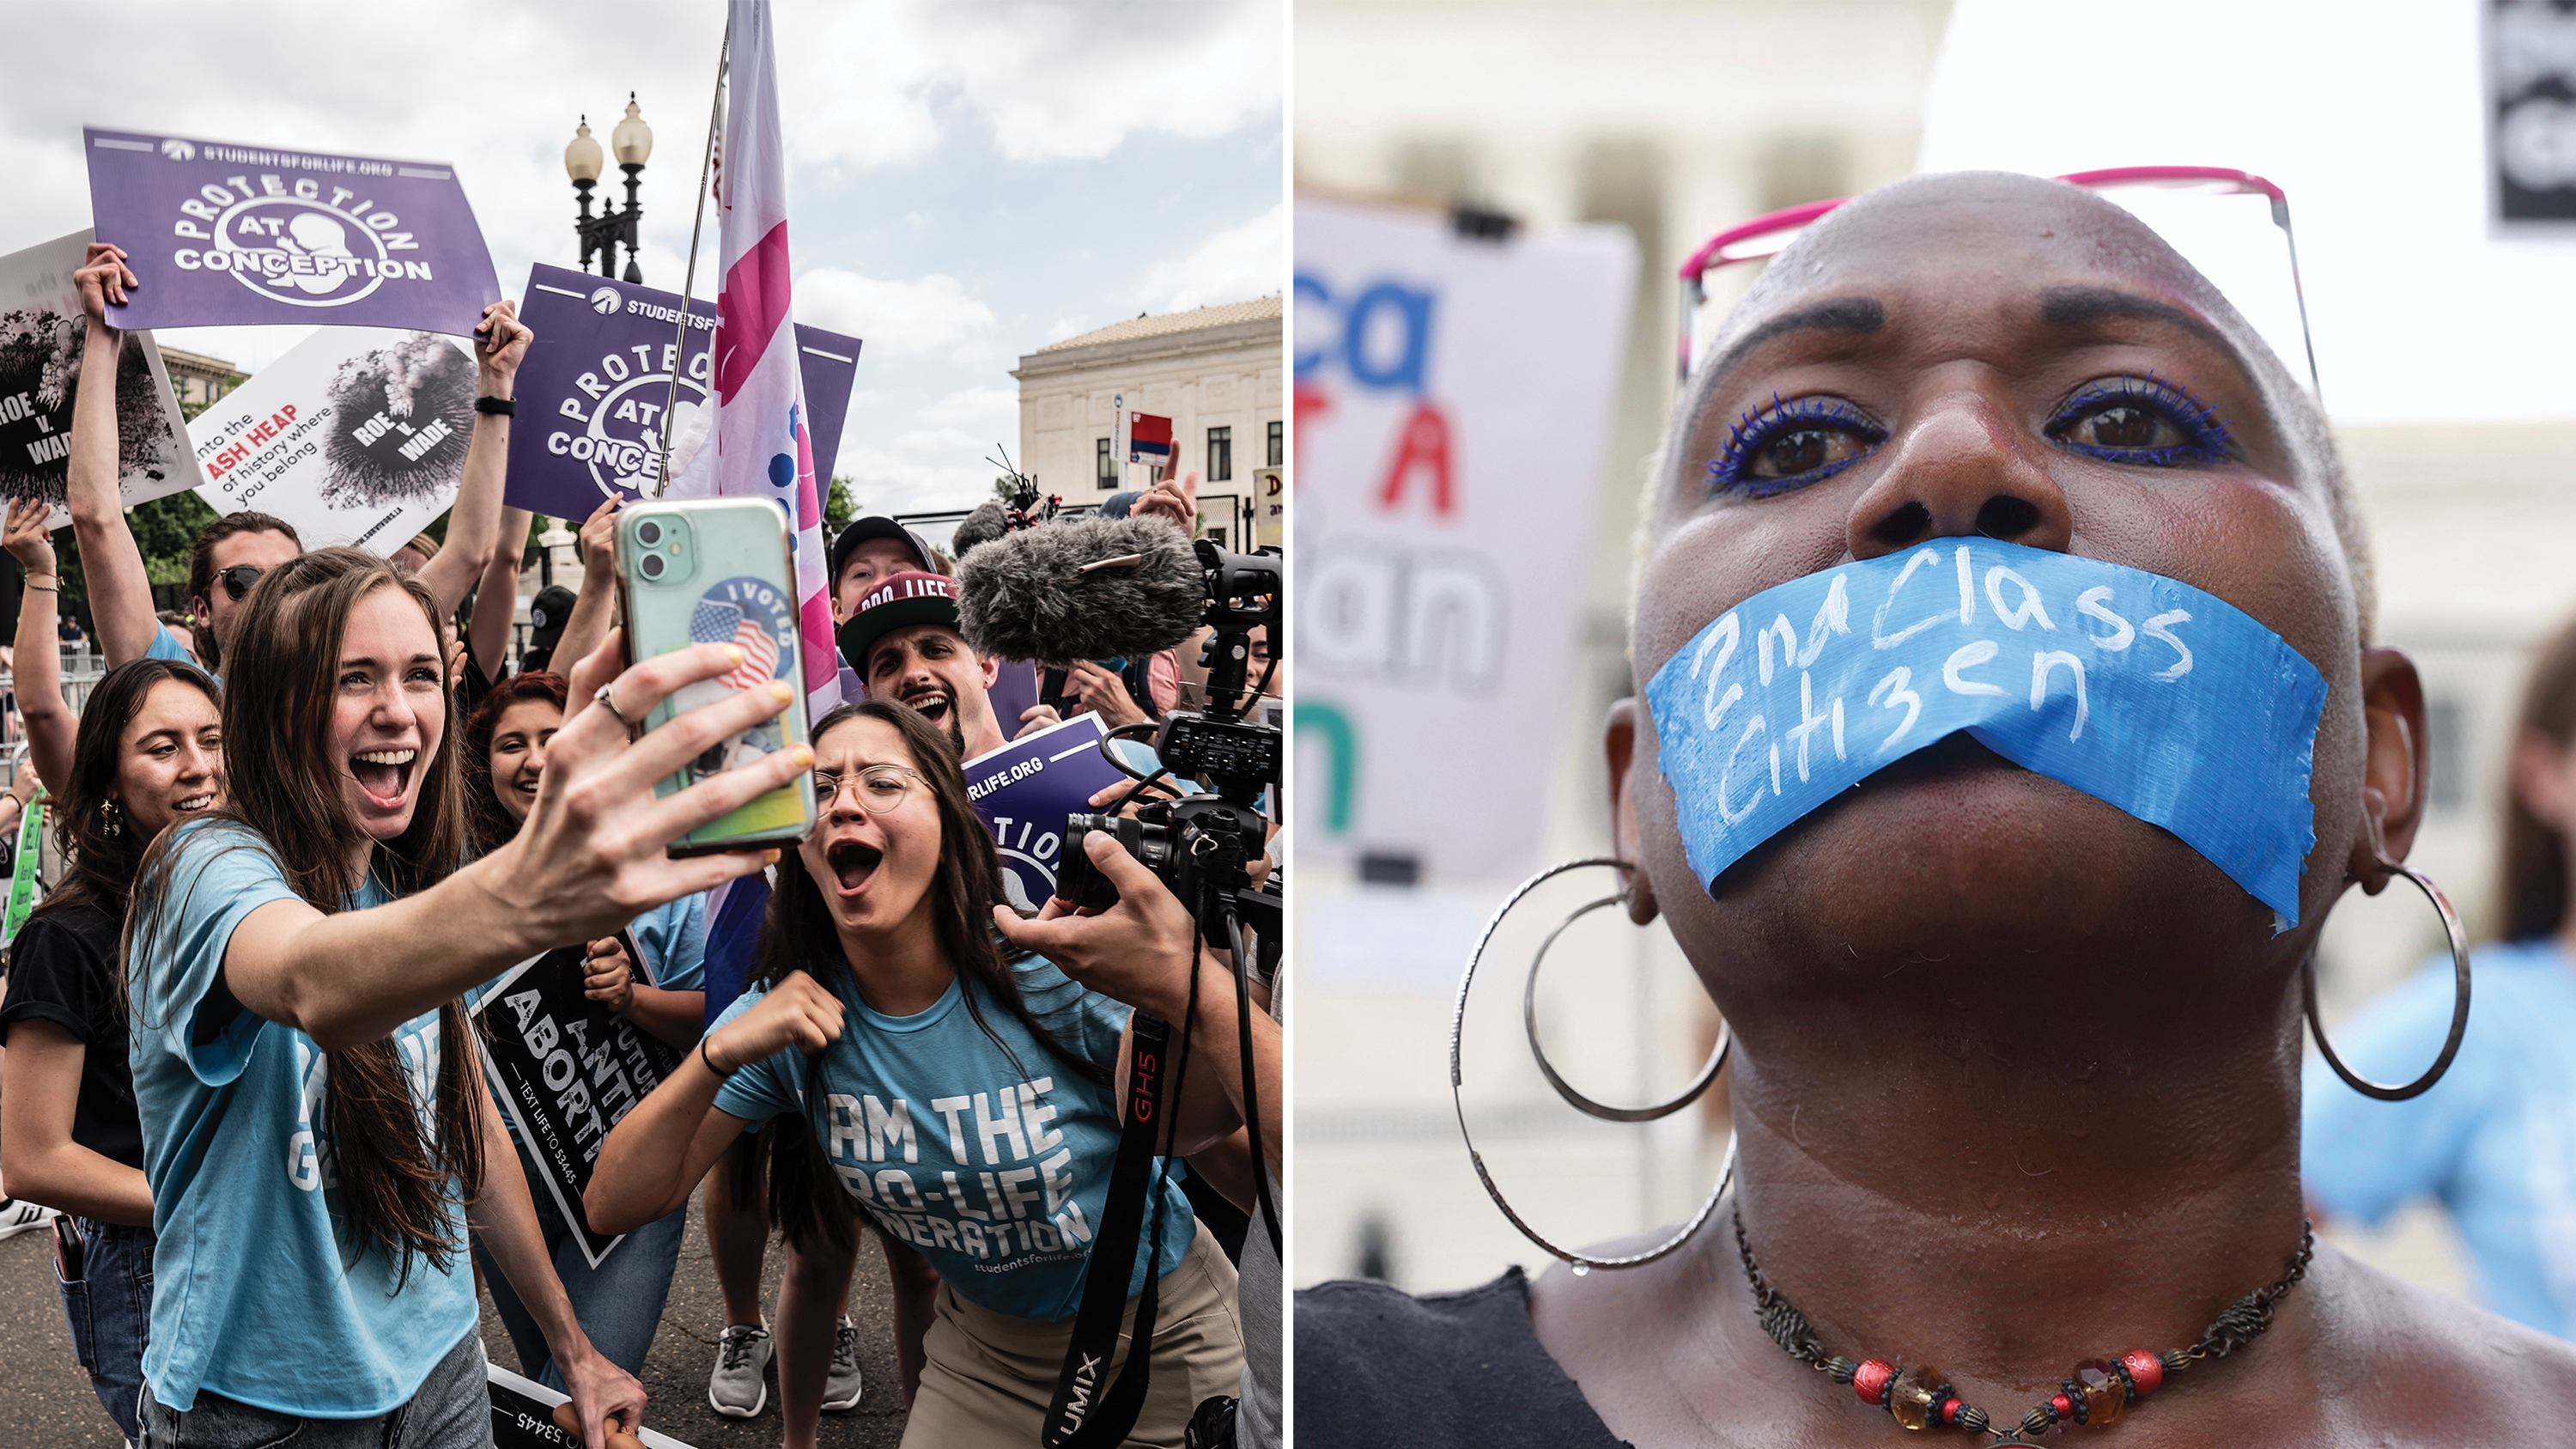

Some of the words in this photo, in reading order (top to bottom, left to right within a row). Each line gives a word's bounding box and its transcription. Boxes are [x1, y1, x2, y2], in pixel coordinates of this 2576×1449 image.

[204, 145, 393, 178] STUDENTSFORLIFE.ORG
[174, 174, 420, 250] PROTECTION
[238, 216, 285, 237] AT
[174, 248, 433, 282] CONCEPTION
[206, 441, 251, 481] ASH
[246, 404, 297, 448] HEAP
[224, 414, 254, 436] the
[351, 411, 397, 447] ROE
[398, 417, 453, 462] WADE
[613, 399, 661, 426] AT
[222, 474, 240, 493] of
[236, 440, 289, 480] history
[287, 407, 332, 441] where
[236, 481, 265, 508] you
[262, 441, 318, 483] belong
[726, 584, 738, 601] I
[742, 581, 793, 648] VOTED
[905, 579, 949, 598] LIFE
[1690, 572, 1853, 732] 2nd
[1871, 544, 2193, 683] Class
[966, 756, 1045, 803] RLIFE.ORG
[993, 816, 1061, 872] TIO
[1135, 1051, 1157, 1123] GH5
[519, 1080, 540, 1109] TEXT
[533, 1108, 552, 1135] LIFE
[546, 1131, 559, 1149] TO
[554, 1148, 577, 1184] 53445
[823, 1093, 918, 1164] AM
[931, 1076, 1064, 1166] THE
[865, 1200, 1093, 1260] NERATION
[1052, 1351, 1102, 1446] UMIX
